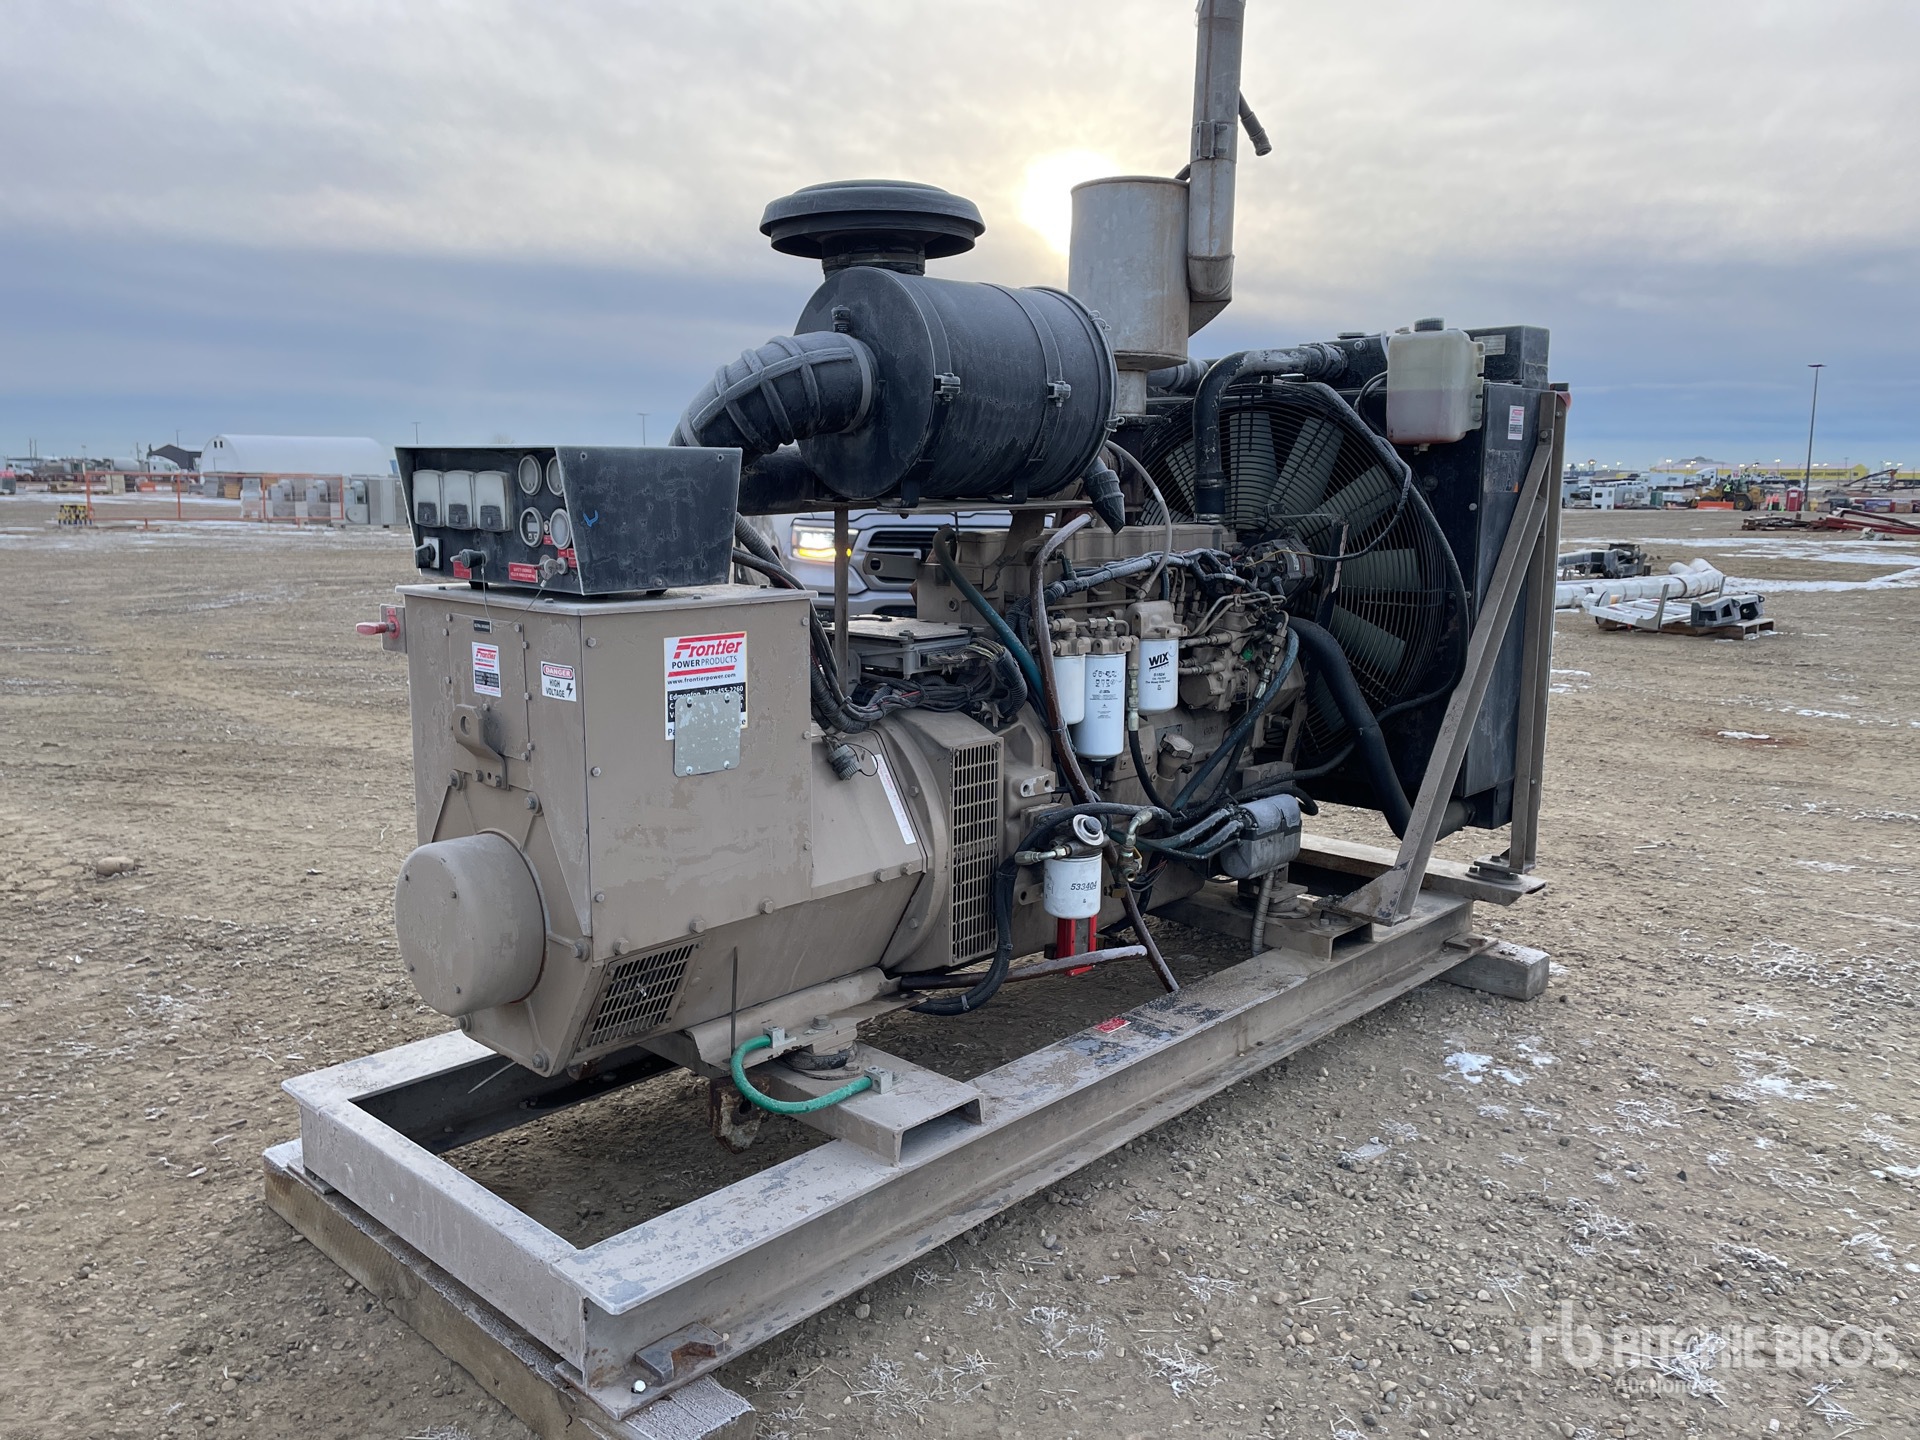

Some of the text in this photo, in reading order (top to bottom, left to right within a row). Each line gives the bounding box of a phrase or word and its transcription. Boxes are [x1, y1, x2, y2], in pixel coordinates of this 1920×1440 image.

[673, 634, 744, 659] Frontier
[1149, 651, 1169, 665] WIX
[545, 665, 571, 678] DANGER
[549, 679, 561, 689] HIGH
[667, 672, 736, 685] www.frontierpower.com
[545, 687, 566, 698] VOLTAGE
